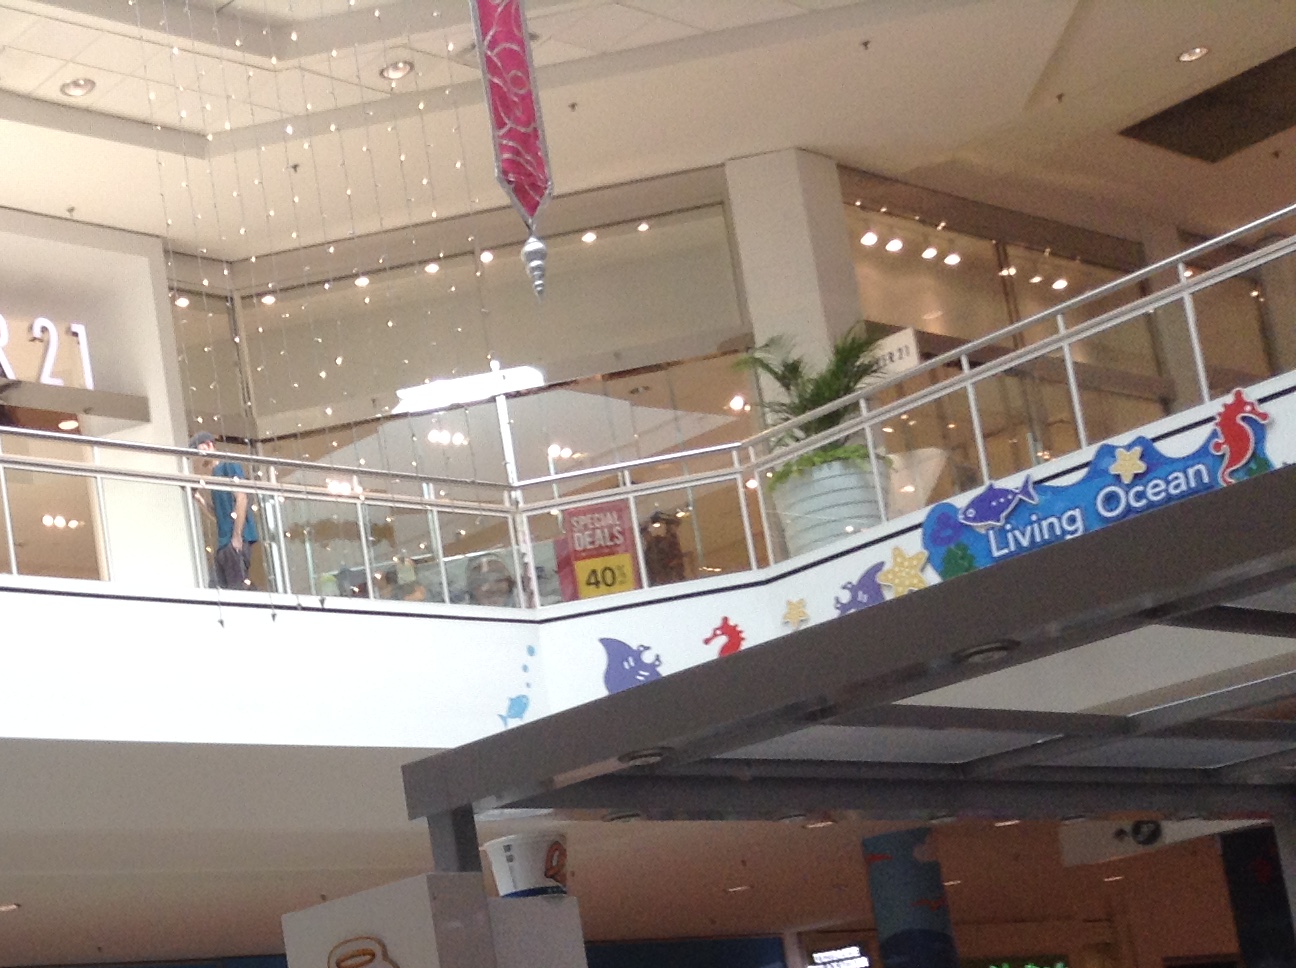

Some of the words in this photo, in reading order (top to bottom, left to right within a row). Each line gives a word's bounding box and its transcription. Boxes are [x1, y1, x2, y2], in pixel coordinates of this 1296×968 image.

[29, 316, 95, 391] 21
[571, 511, 621, 529] SPECIAL
[988, 507, 1085, 557] Living
[1096, 463, 1209, 517] Ocean
[573, 526, 625, 550] DEALS
